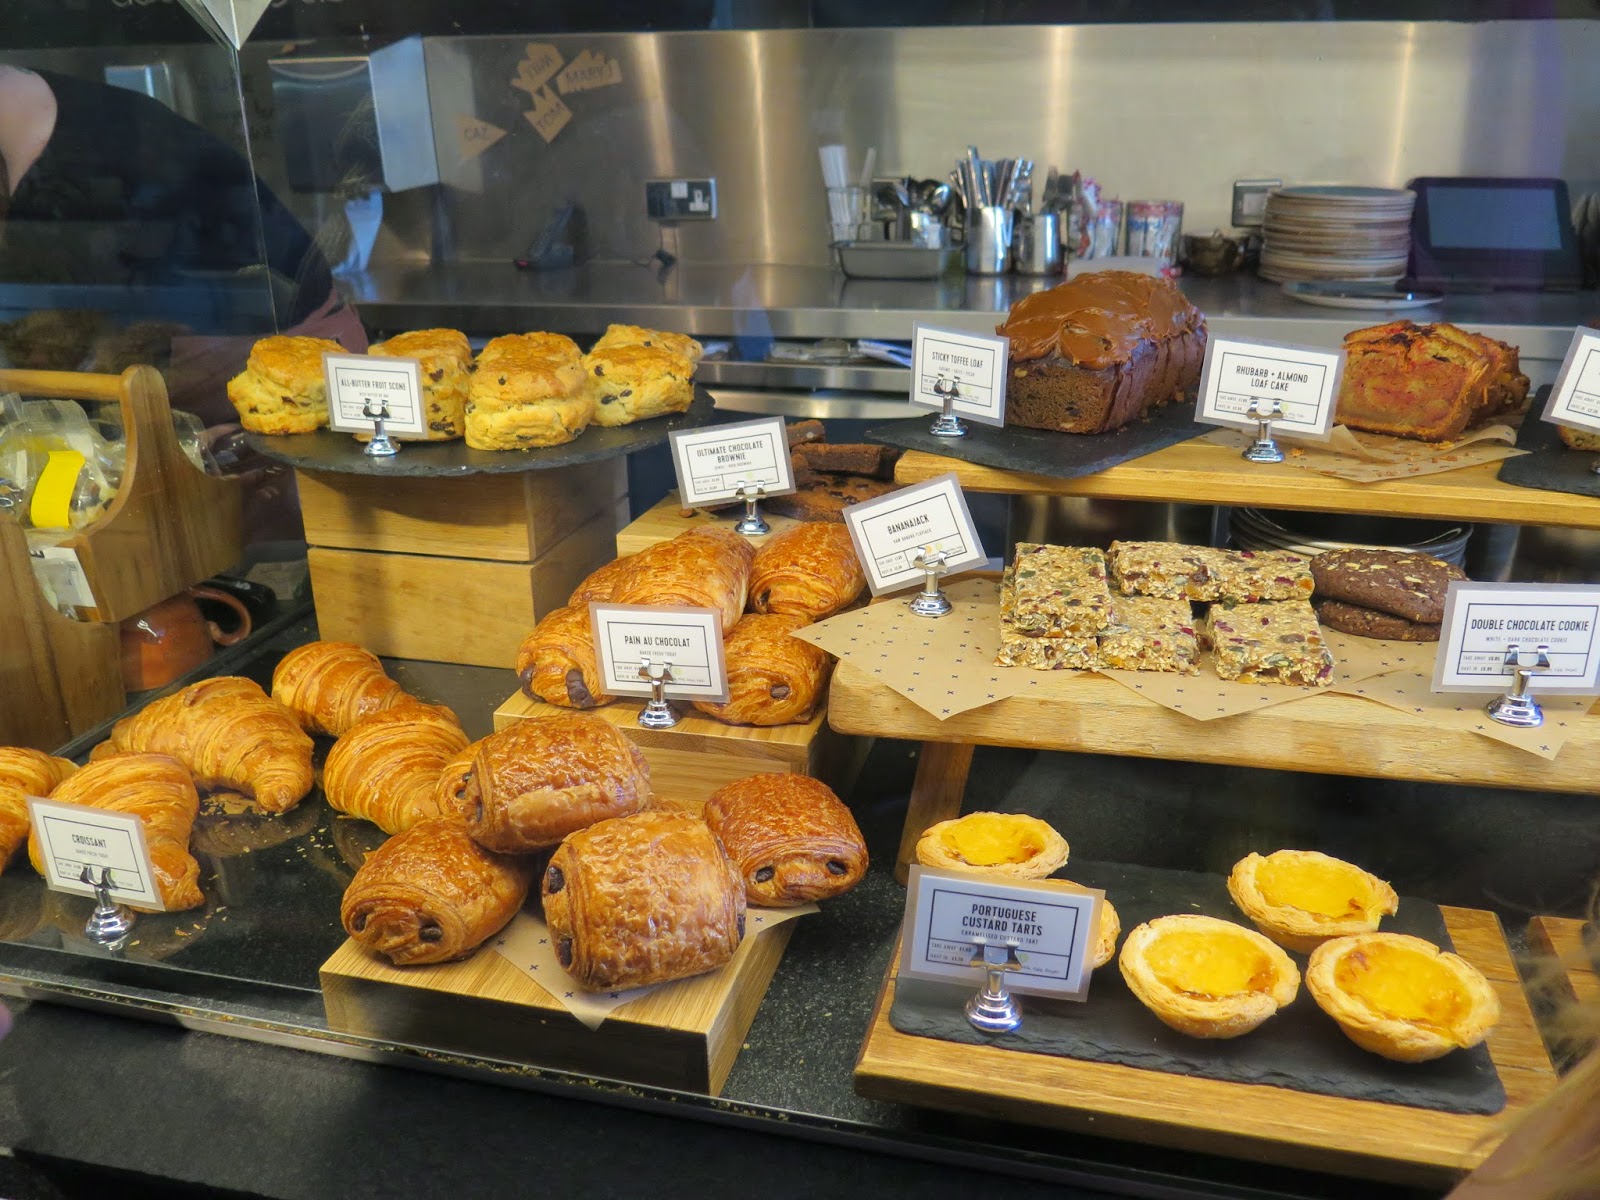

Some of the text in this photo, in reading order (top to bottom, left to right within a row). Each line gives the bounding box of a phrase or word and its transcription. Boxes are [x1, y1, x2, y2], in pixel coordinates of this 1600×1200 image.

[932, 351, 984, 368] STICKY TOFFEE LOAF
[1236, 365, 1268, 378] RHUBARB
[1277, 371, 1308, 383] ALMOND
[341, 379, 406, 391] ALL-BUTTER FRUIT SCONE
[1251, 378, 1289, 392] LOAF CAKE
[696, 440, 764, 457] ULTIMATE CHOCOLATE
[717, 452, 746, 463] BROWNIE
[887, 514, 930, 534] BANANAJACK
[1471, 619, 1590, 631] DOUBLE CHOCOLATE COOKIE
[624, 635, 690, 647] PAIN AU CHOCOLAT
[72, 834, 107, 848] CROISSANT
[972, 903, 1037, 923] PORTUGUESE
[962, 915, 1043, 936] CUSTARD TARTS
[1026, 937, 1039, 945] TART
